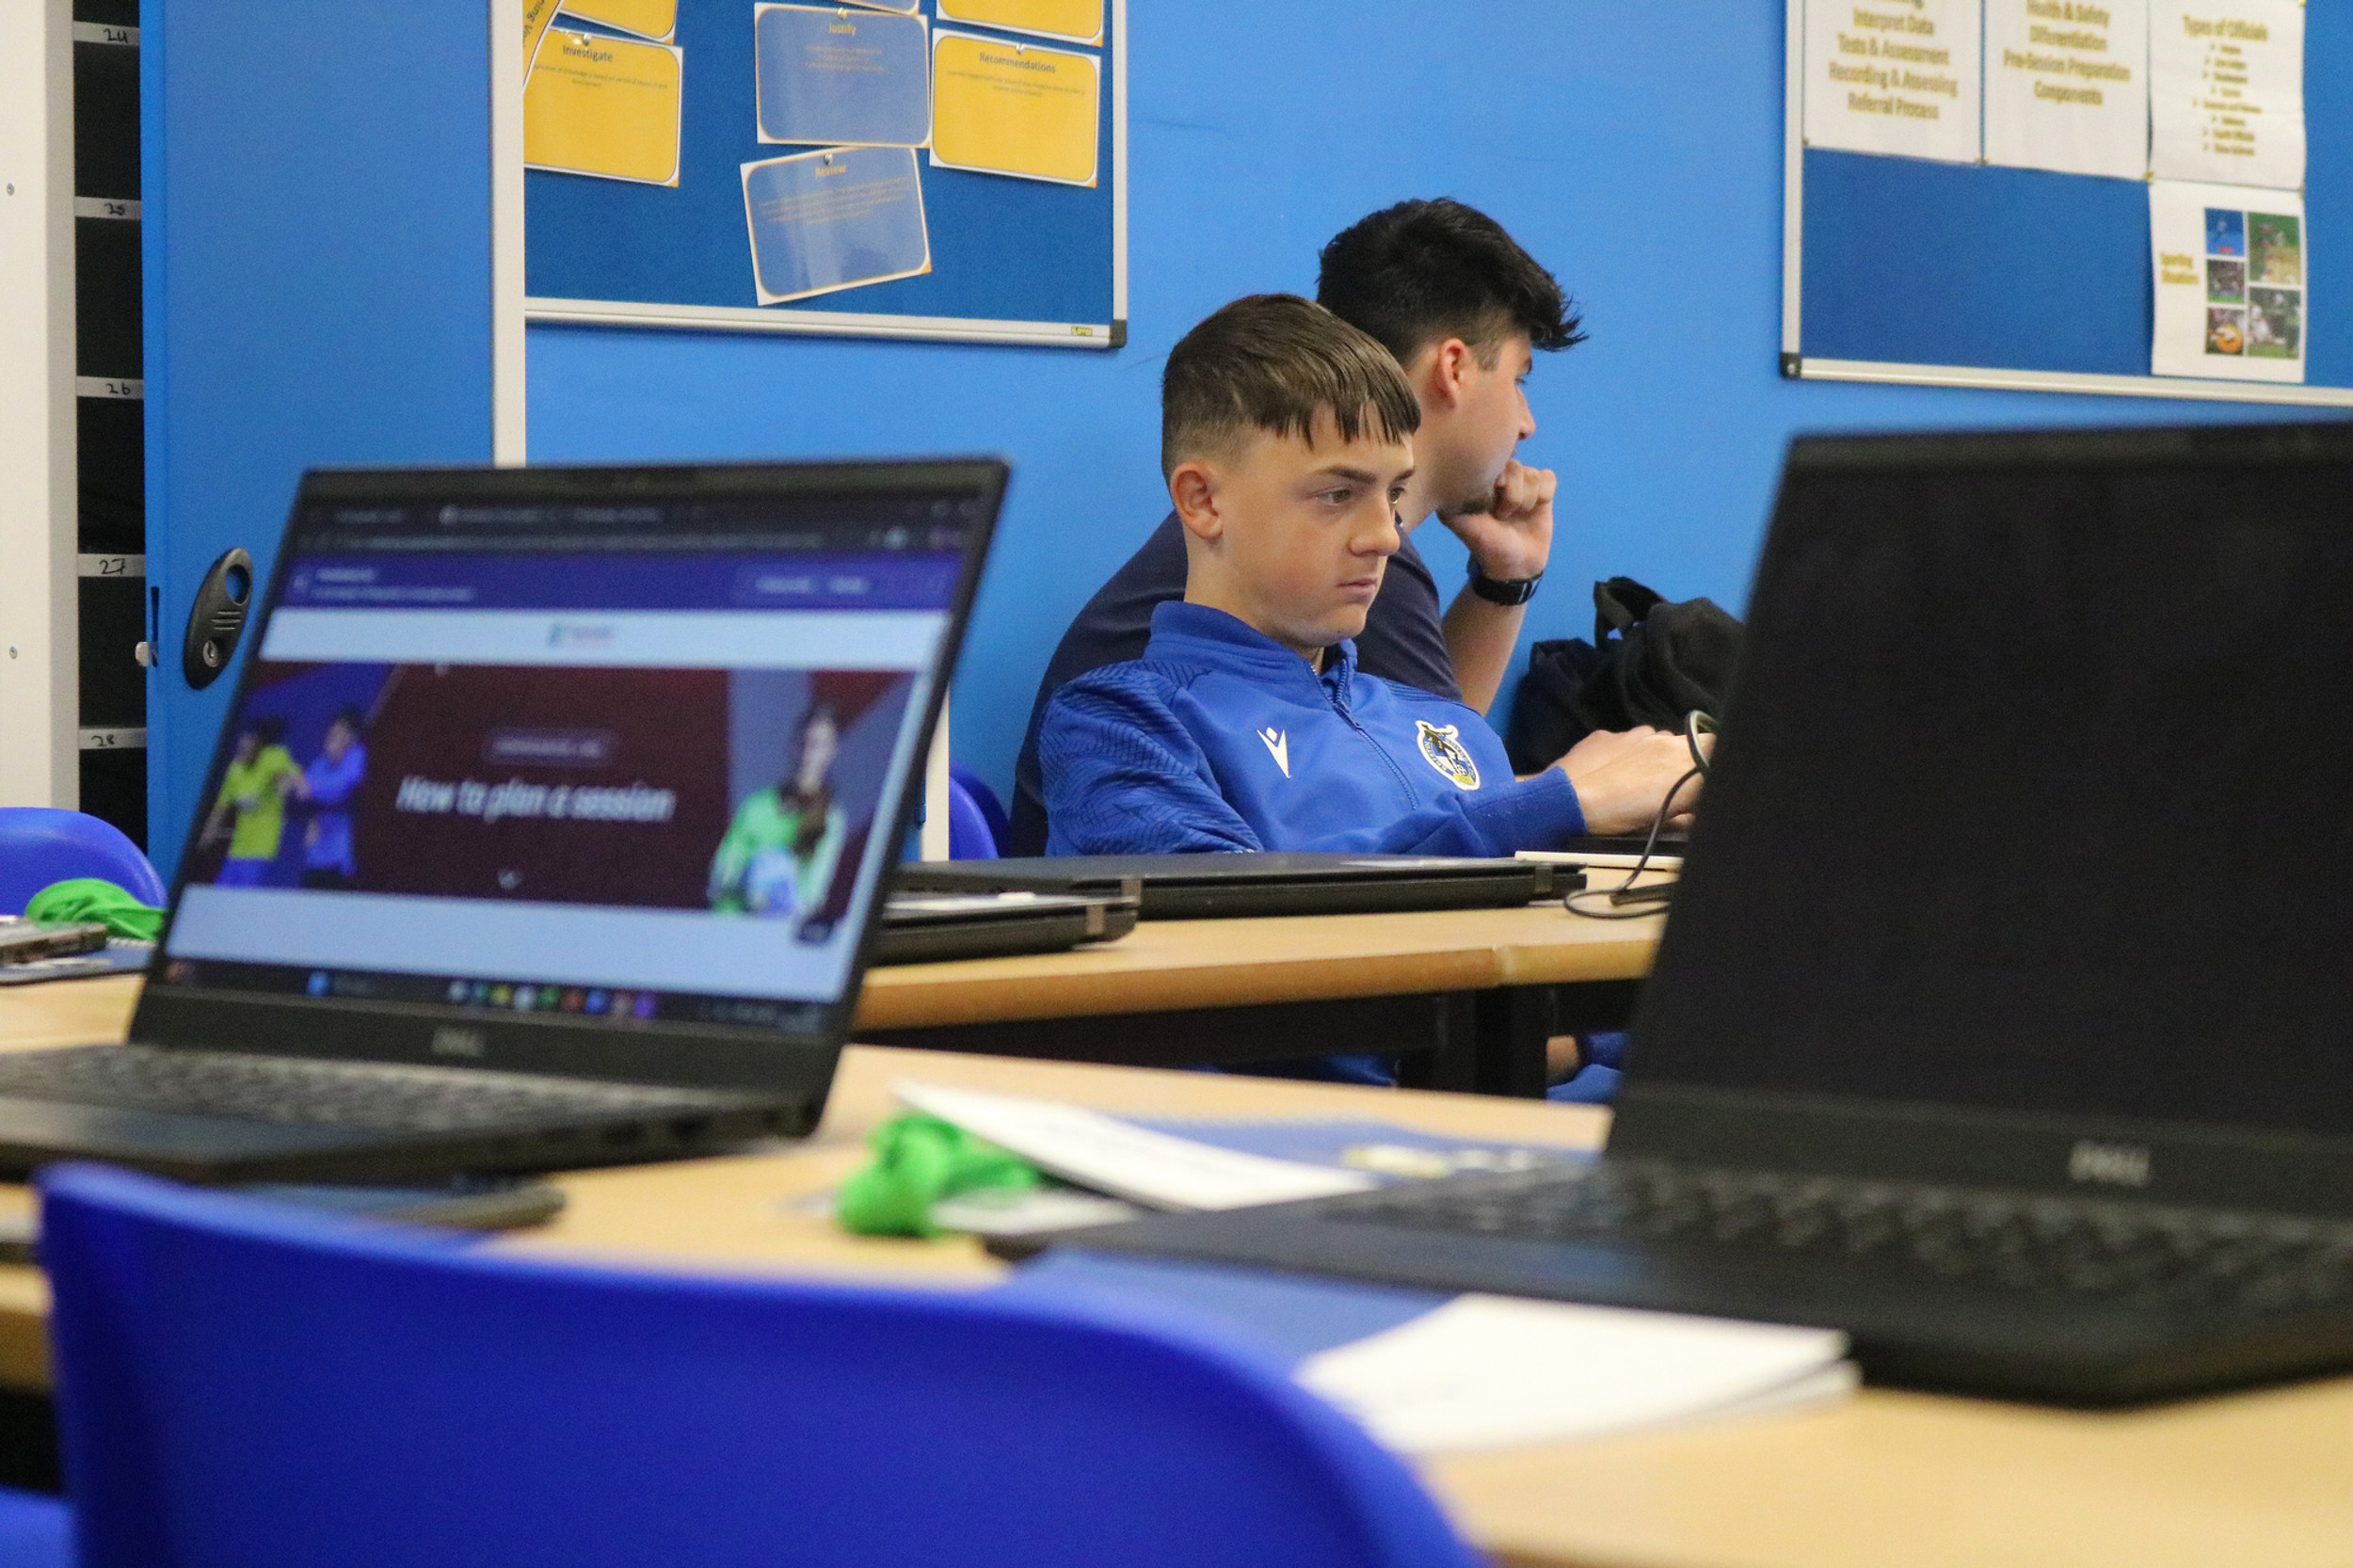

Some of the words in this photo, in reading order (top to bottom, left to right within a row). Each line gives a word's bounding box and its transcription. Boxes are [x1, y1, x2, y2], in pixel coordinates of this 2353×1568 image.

[1852, 8, 1905, 32] Interpret
[1907, 15, 1934, 37] Data
[2076, 5, 2110, 28] Safety
[2182, 14, 2212, 37] Types
[2214, 18, 2226, 36] of
[2228, 20, 2268, 41] Officials
[104, 28, 128, 42] 24
[828, 23, 857, 37] Justify
[562, 44, 614, 63] Investigate
[1837, 32, 1866, 56] Tests
[1869, 37, 1879, 56] &
[1881, 40, 1950, 66] Assessment
[980, 51, 1057, 74] Recommendations
[2068, 57, 2131, 82] Preparation
[1829, 60, 1887, 90] Recording
[1890, 68, 1899, 87] &
[2034, 80, 2103, 105] Components
[1848, 92, 1893, 115] Referral
[1896, 97, 1940, 120] Process
[814, 165, 846, 179] Review
[104, 202, 125, 216] 25
[106, 383, 131, 395] 26
[99, 558, 126, 576] 27
[91, 734, 115, 747] 28
[396, 776, 454, 813] How
[456, 778, 488, 815] to
[484, 777, 549, 824] plan
[548, 784, 572, 819] a
[571, 780, 676, 822] session
